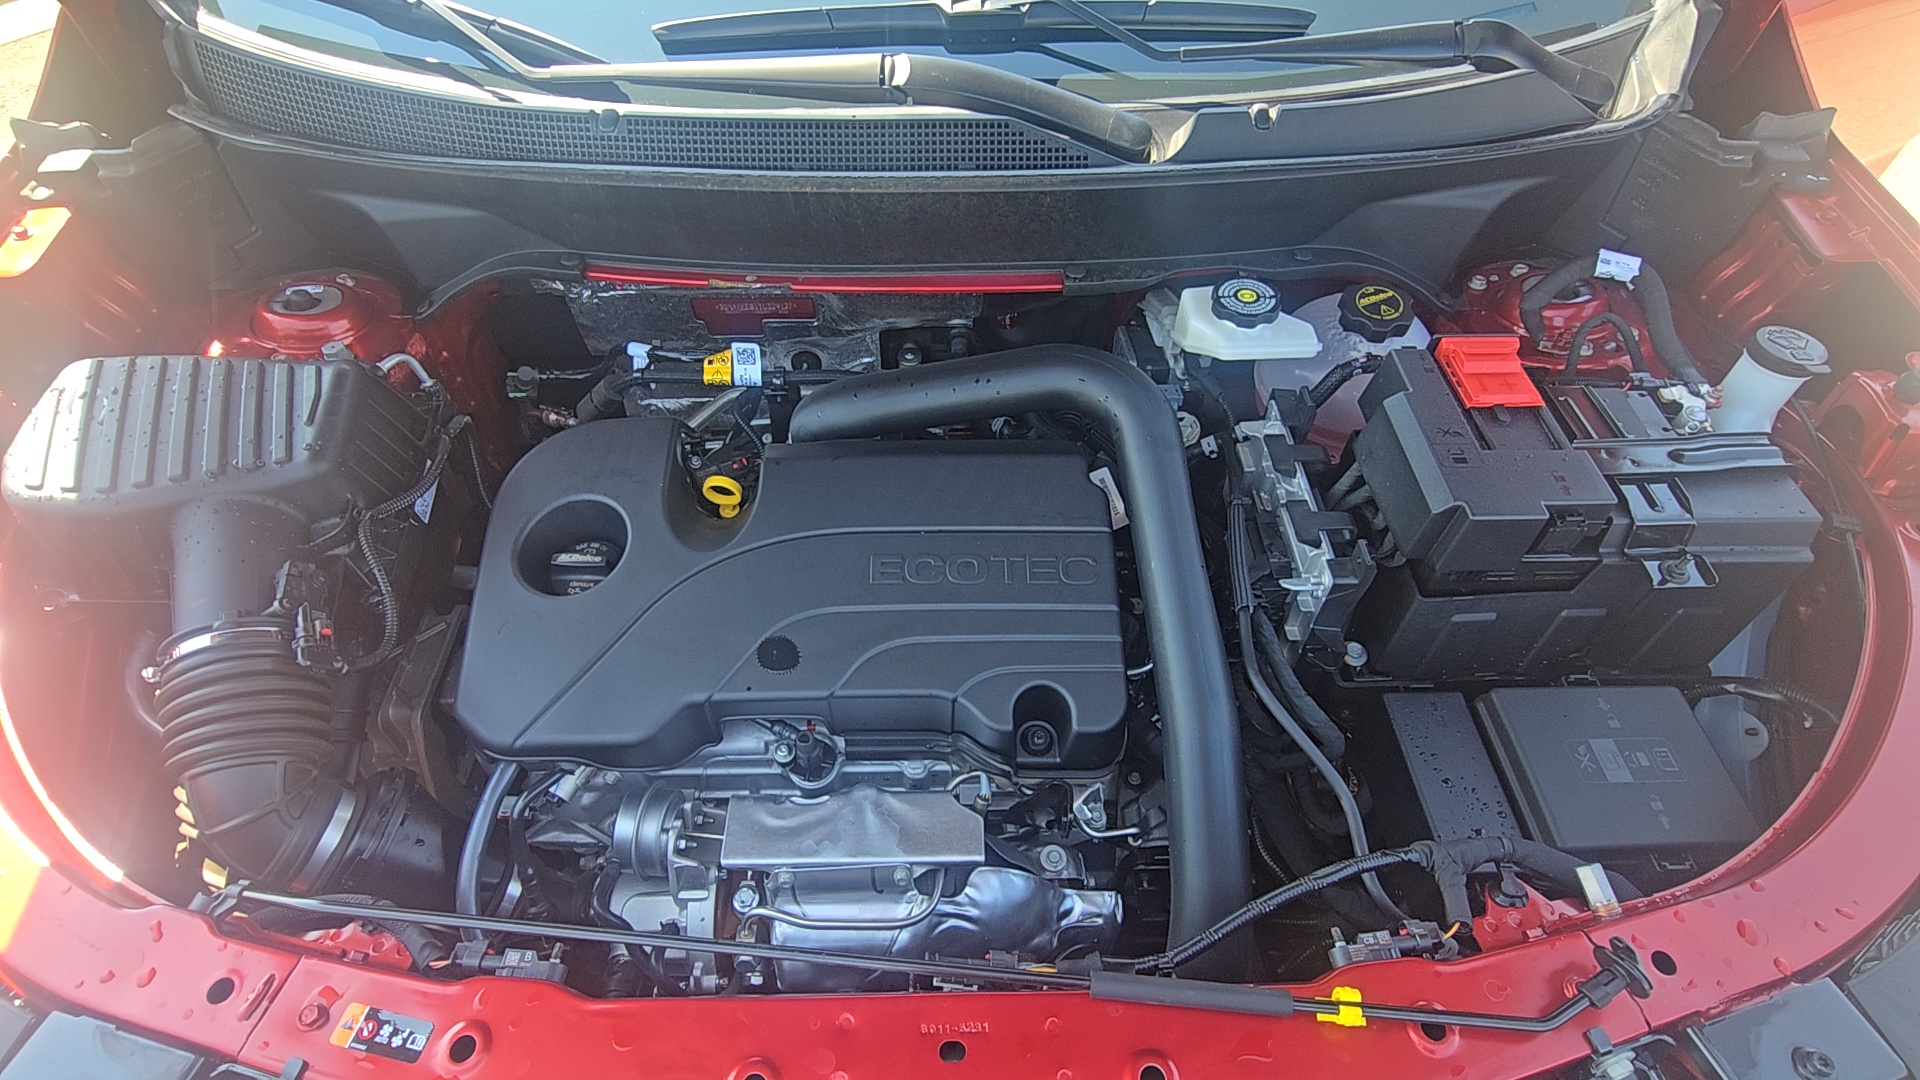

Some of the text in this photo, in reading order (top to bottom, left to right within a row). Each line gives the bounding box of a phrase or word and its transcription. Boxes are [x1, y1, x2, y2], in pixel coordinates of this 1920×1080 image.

[1359, 291, 1394, 306] ACDelco
[556, 553, 603, 563] ACDelco
[868, 554, 1098, 586] ECOTEC
[524, 951, 533, 962] B
